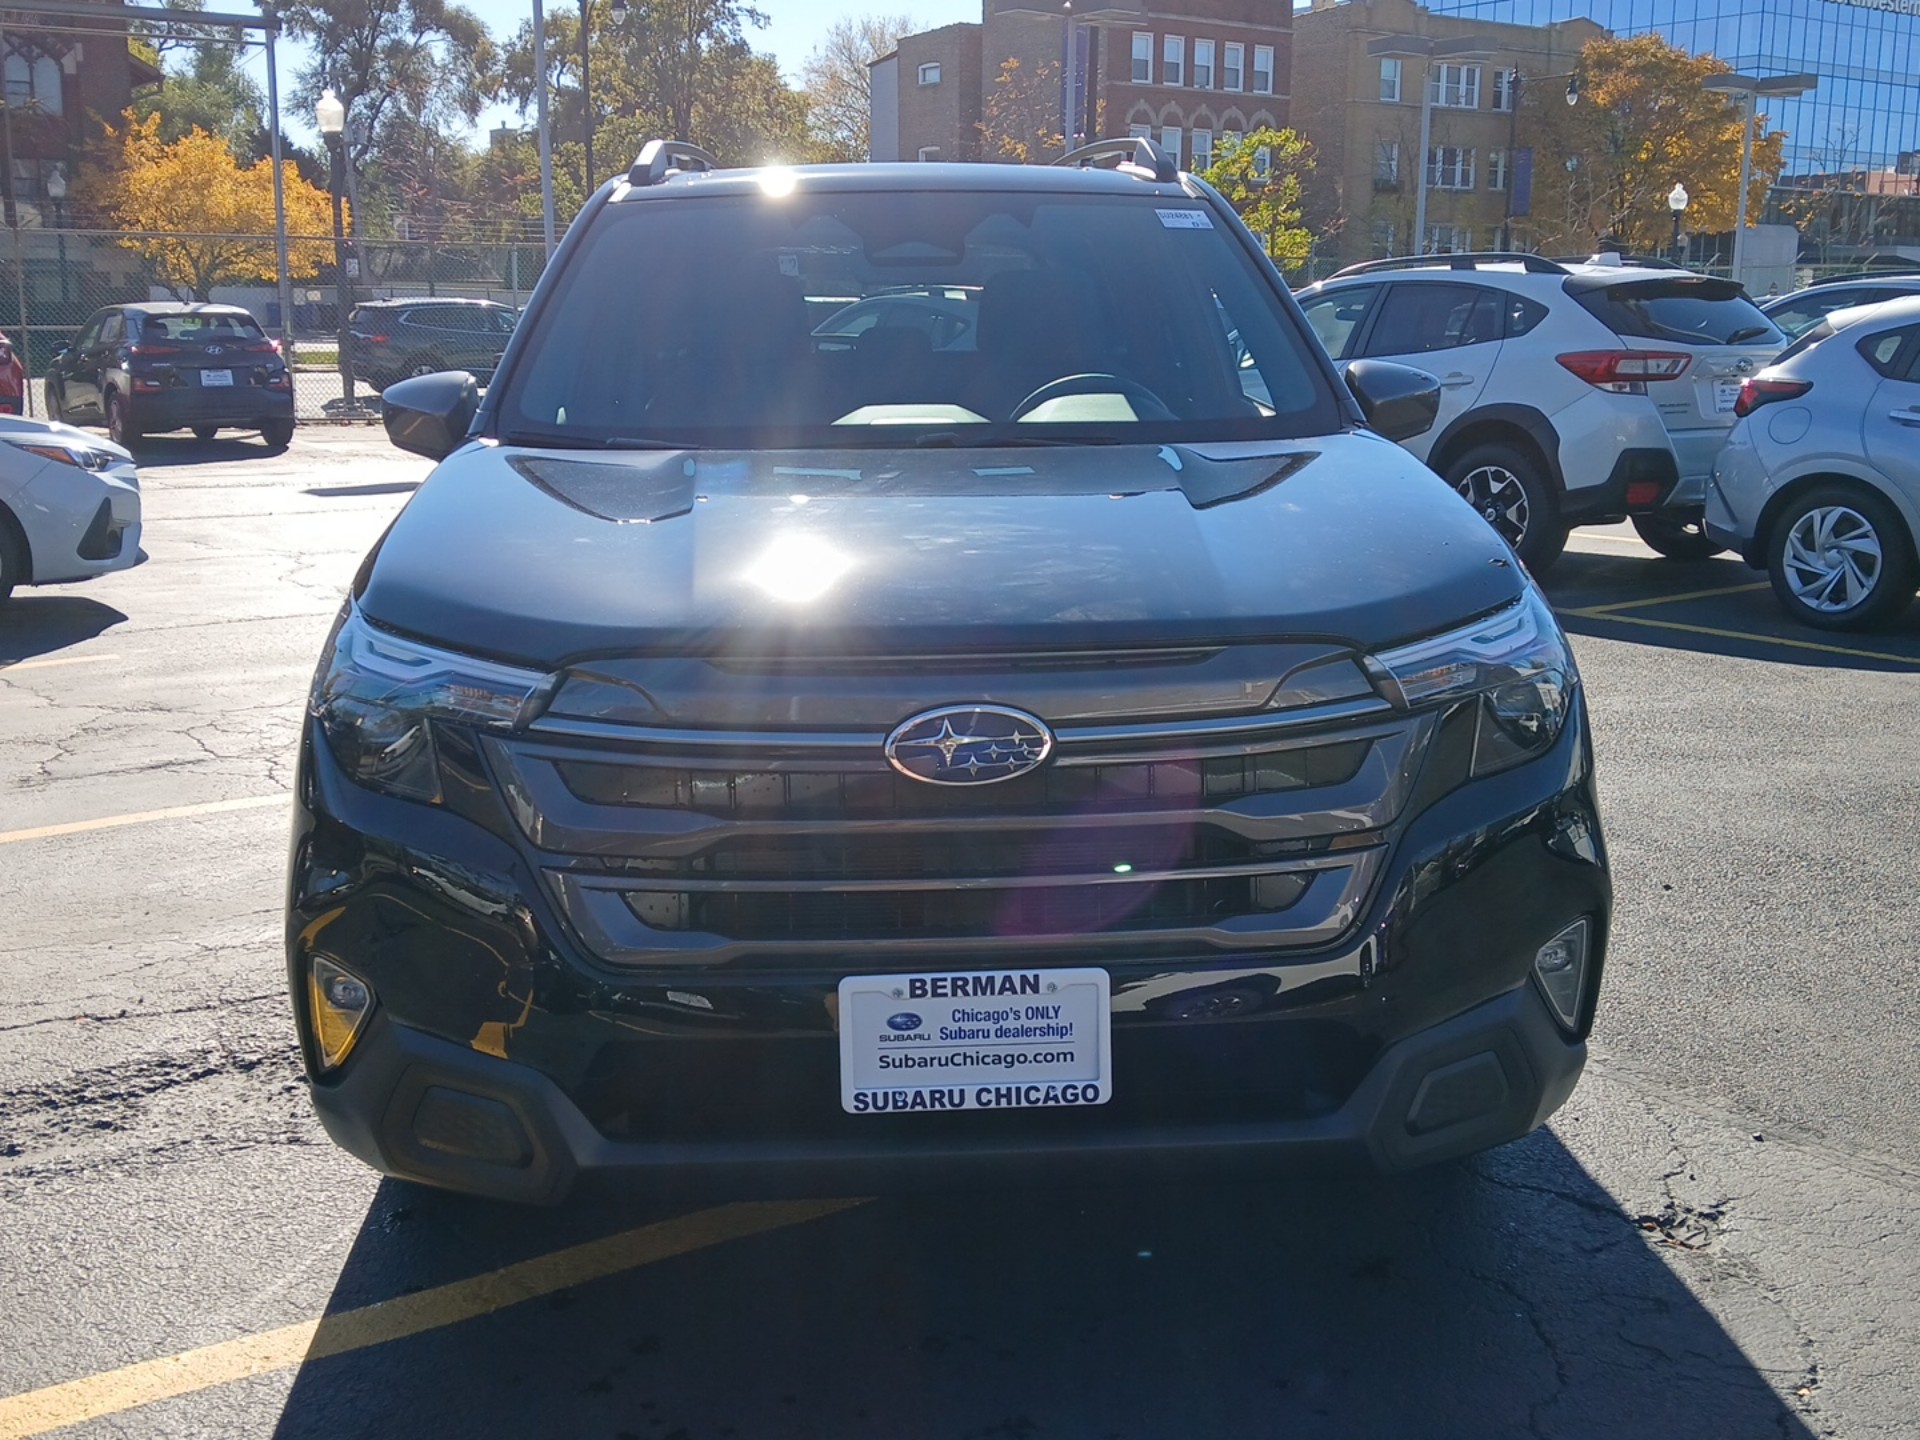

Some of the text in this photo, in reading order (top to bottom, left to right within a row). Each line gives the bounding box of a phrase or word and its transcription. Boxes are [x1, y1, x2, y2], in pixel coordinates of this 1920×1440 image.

[909, 974, 1040, 999] BERMAN
[952, 1005, 1061, 1025] Chicago's ONLY
[879, 1033, 931, 1042] SUBARU
[939, 1023, 1073, 1041] Subaru dealership!
[878, 1050, 1075, 1069] SubaruChicago.com
[853, 1083, 1100, 1112] SUBARU CHICAGO
